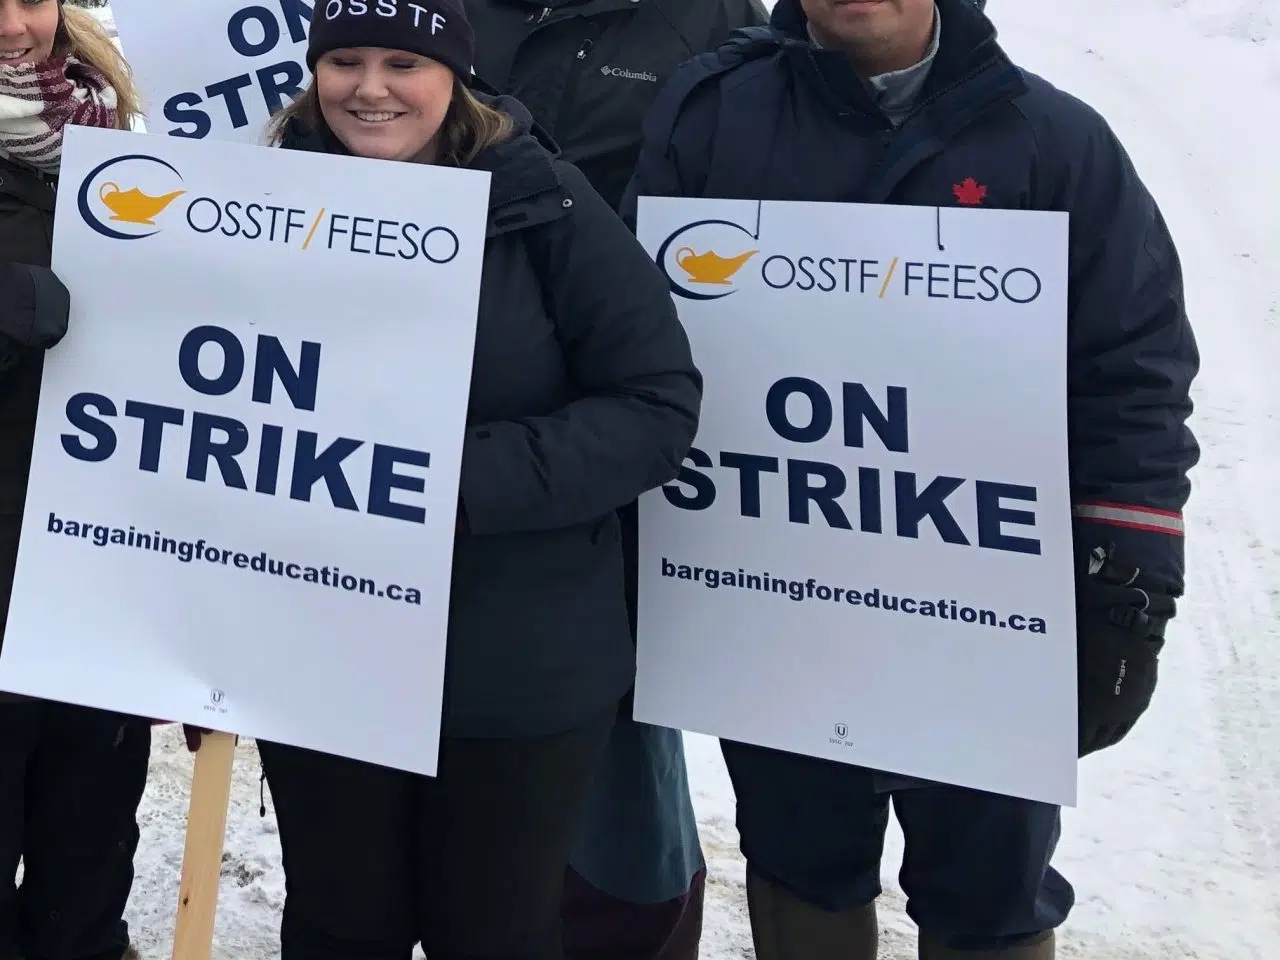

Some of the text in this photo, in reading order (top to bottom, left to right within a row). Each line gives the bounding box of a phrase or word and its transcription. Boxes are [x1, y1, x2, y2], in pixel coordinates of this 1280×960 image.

[611, 67, 657, 83] Columbia
[186, 196, 460, 265] OSSTF/FEESO
[761, 254, 1042, 304] OSSTF/FEESO
[178, 324, 322, 412] ON
[765, 376, 910, 454] ON
[60, 392, 431, 525] STRIKE
[662, 447, 1042, 556] STRIKE
[47, 512, 423, 606] bargainingforeducation.ca
[661, 556, 1047, 635] bargainingforeducation.ca
[1114, 659, 1127, 696] HEAD
